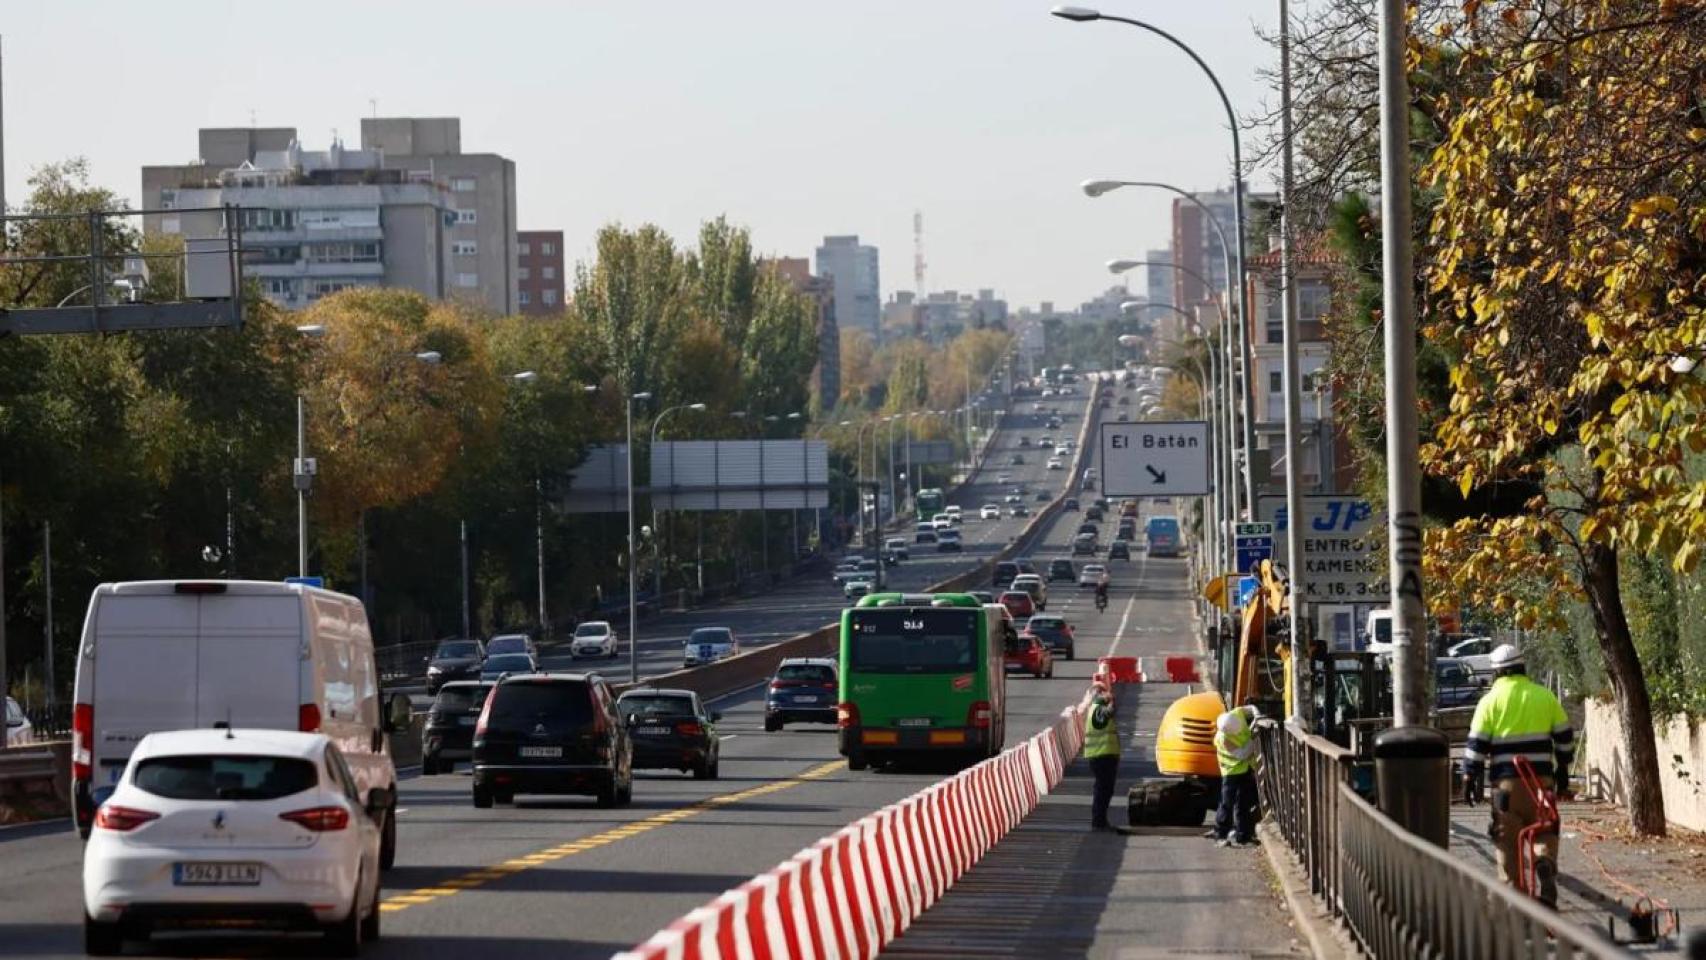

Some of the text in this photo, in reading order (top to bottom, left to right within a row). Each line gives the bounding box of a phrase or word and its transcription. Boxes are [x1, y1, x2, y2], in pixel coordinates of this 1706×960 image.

[1111, 433, 1199, 449] El Batán
[1303, 538, 1365, 553] ENTRO
